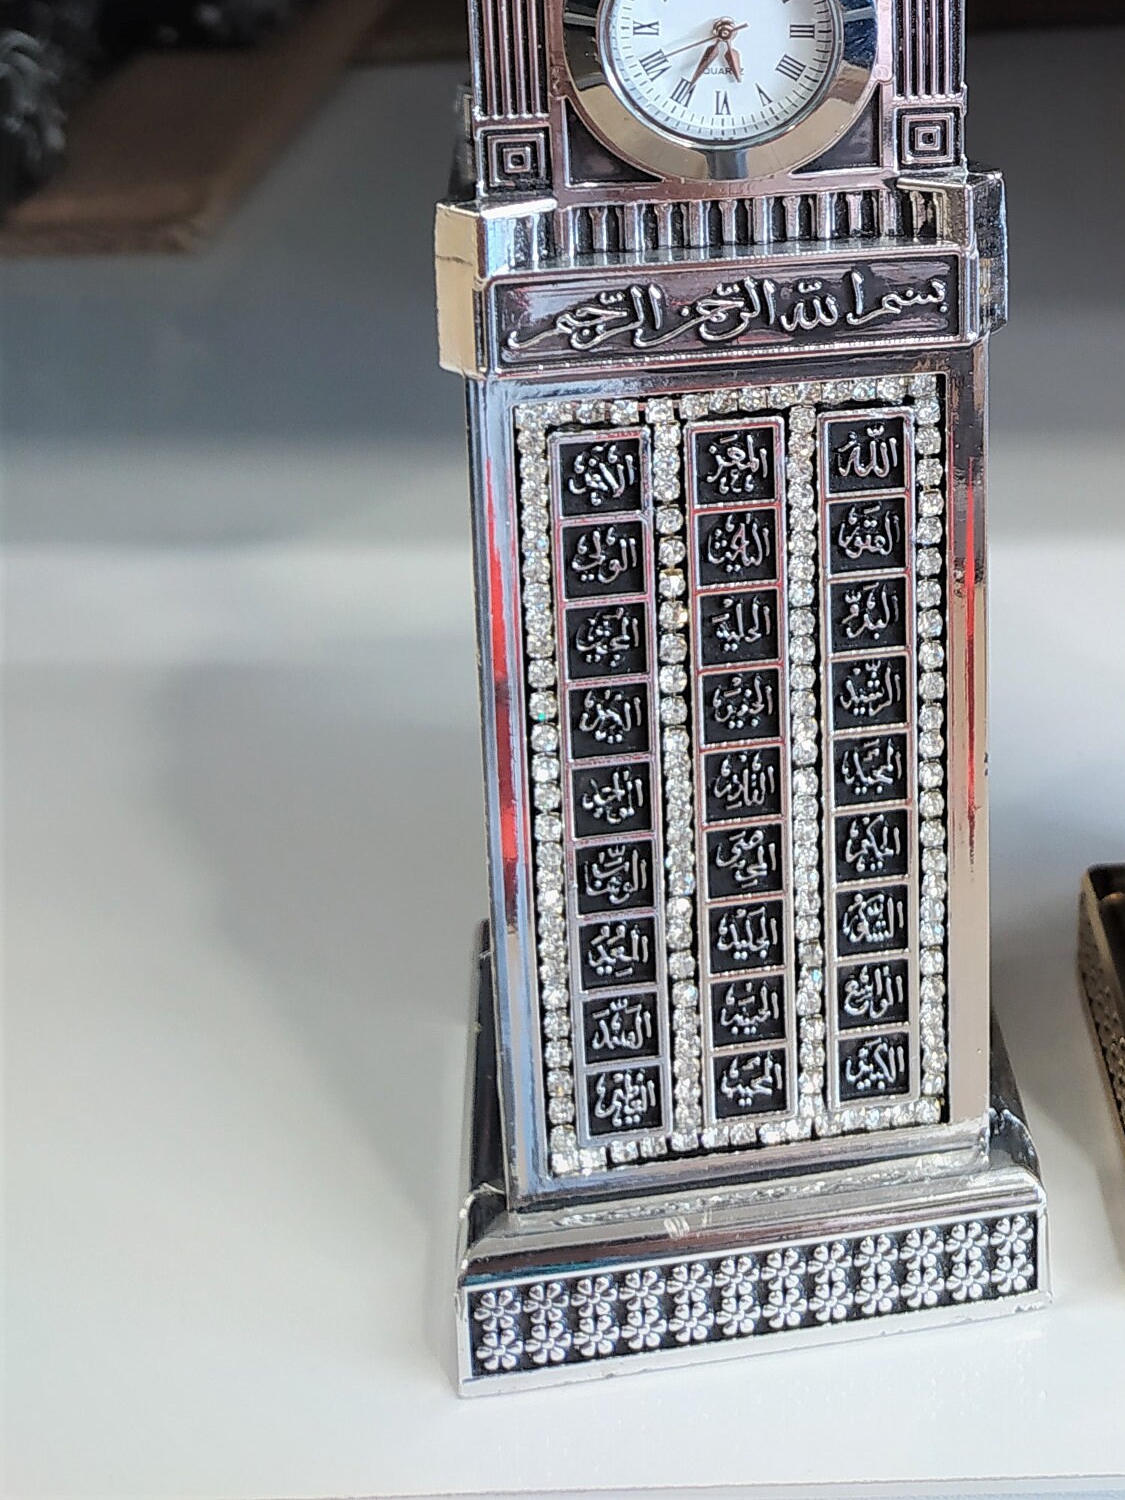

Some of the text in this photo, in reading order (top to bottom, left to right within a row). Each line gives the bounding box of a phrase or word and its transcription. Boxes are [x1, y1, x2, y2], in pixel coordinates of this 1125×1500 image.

[633, 21, 660, 36] IX
[789, 24, 815, 38] III
[703, 67, 744, 76] QUARZ
[755, 83, 773, 107] V
[715, 91, 731, 115] VI
